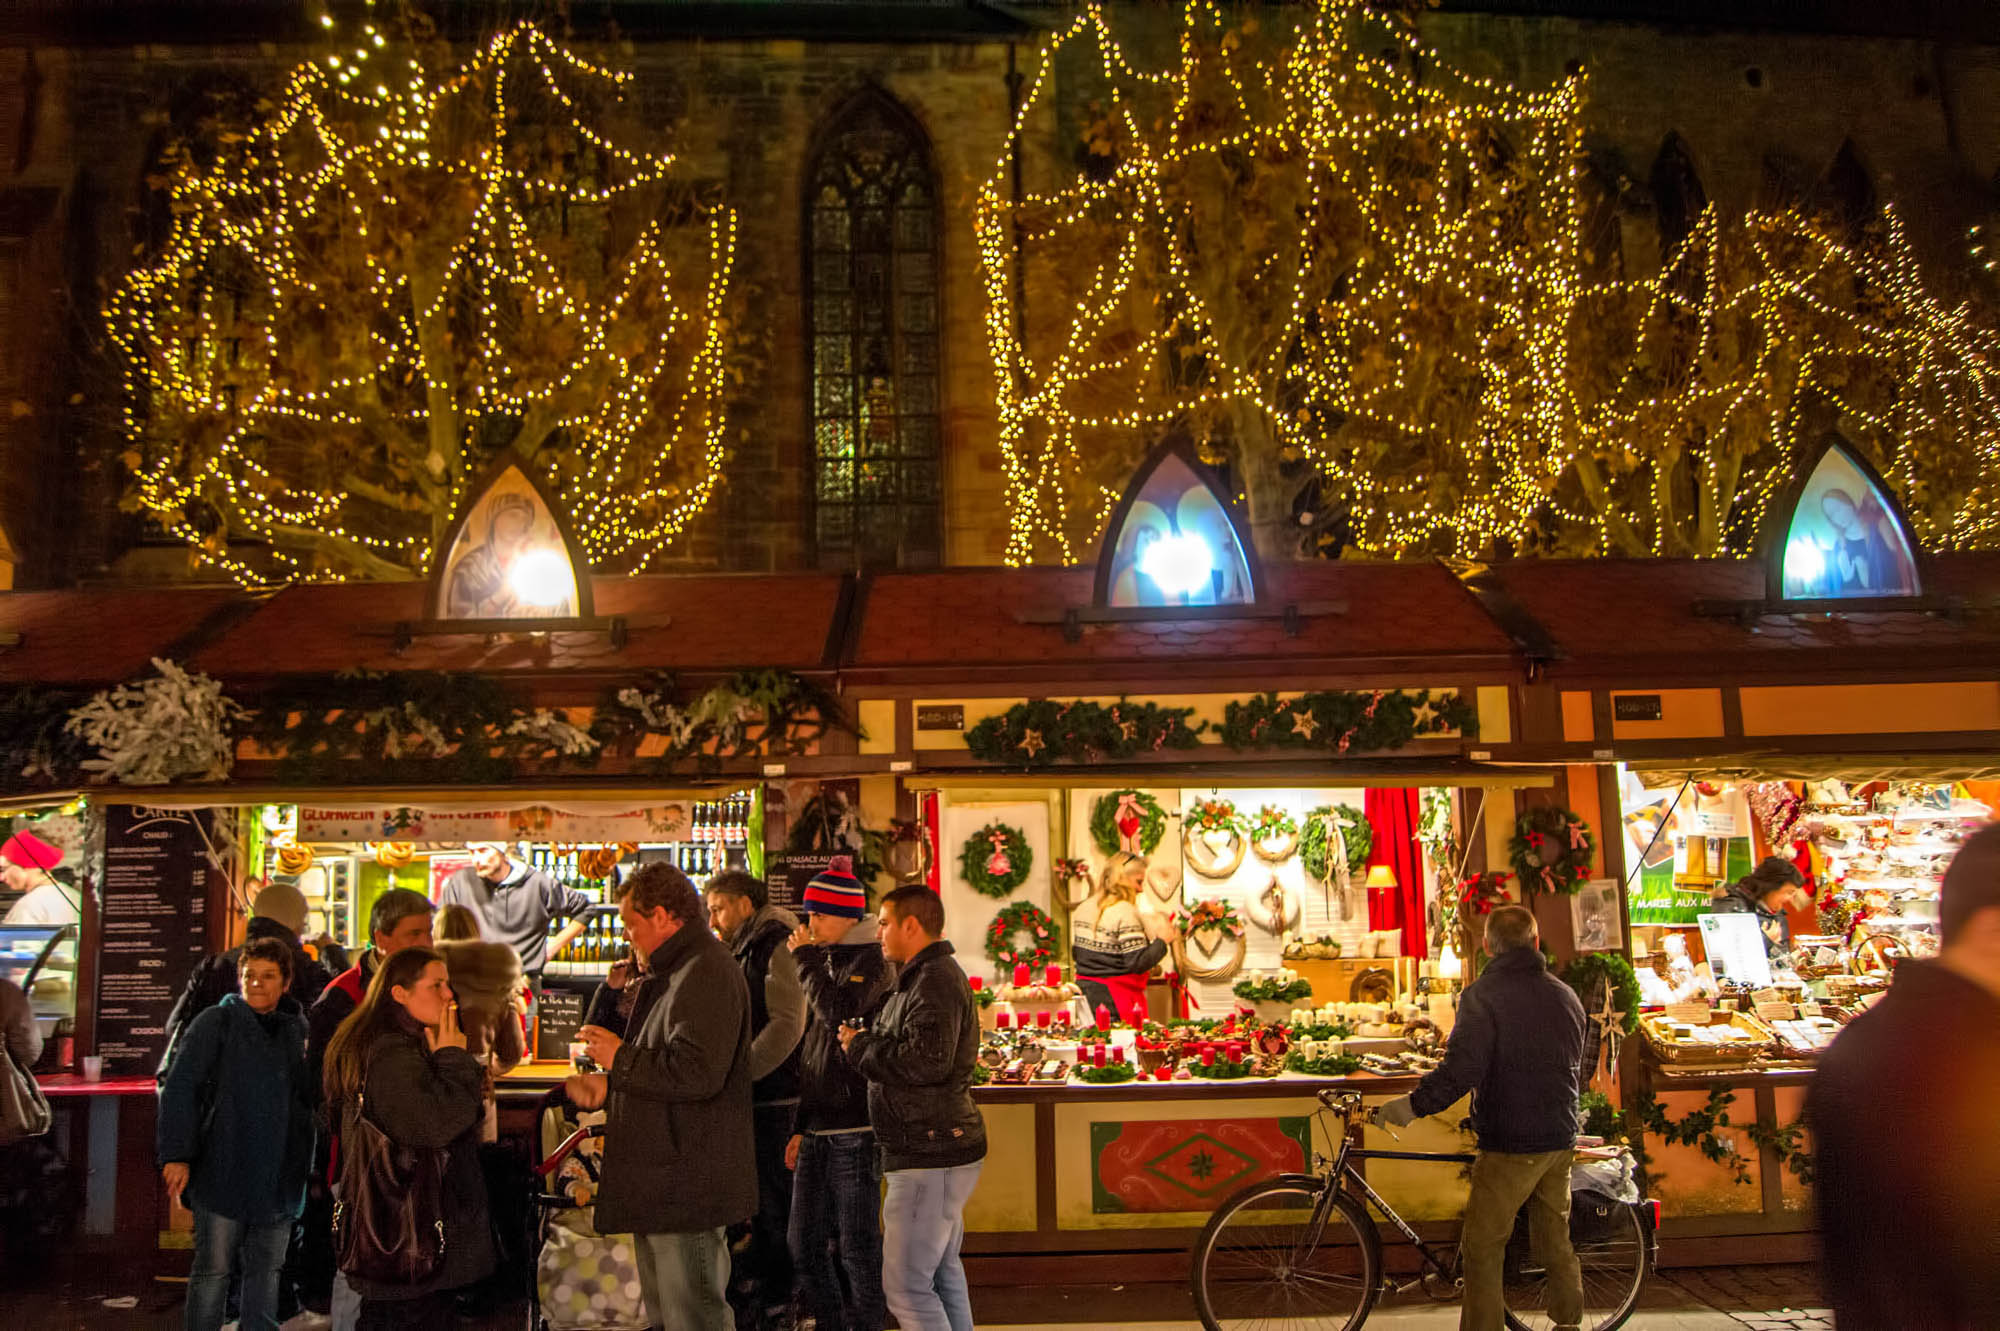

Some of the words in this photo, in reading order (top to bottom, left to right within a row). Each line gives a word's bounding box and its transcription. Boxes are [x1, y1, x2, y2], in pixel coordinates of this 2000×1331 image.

[1637, 898, 1672, 909] MARIE
[1675, 898, 1697, 907] AUX
[1701, 898, 1712, 907] MI
